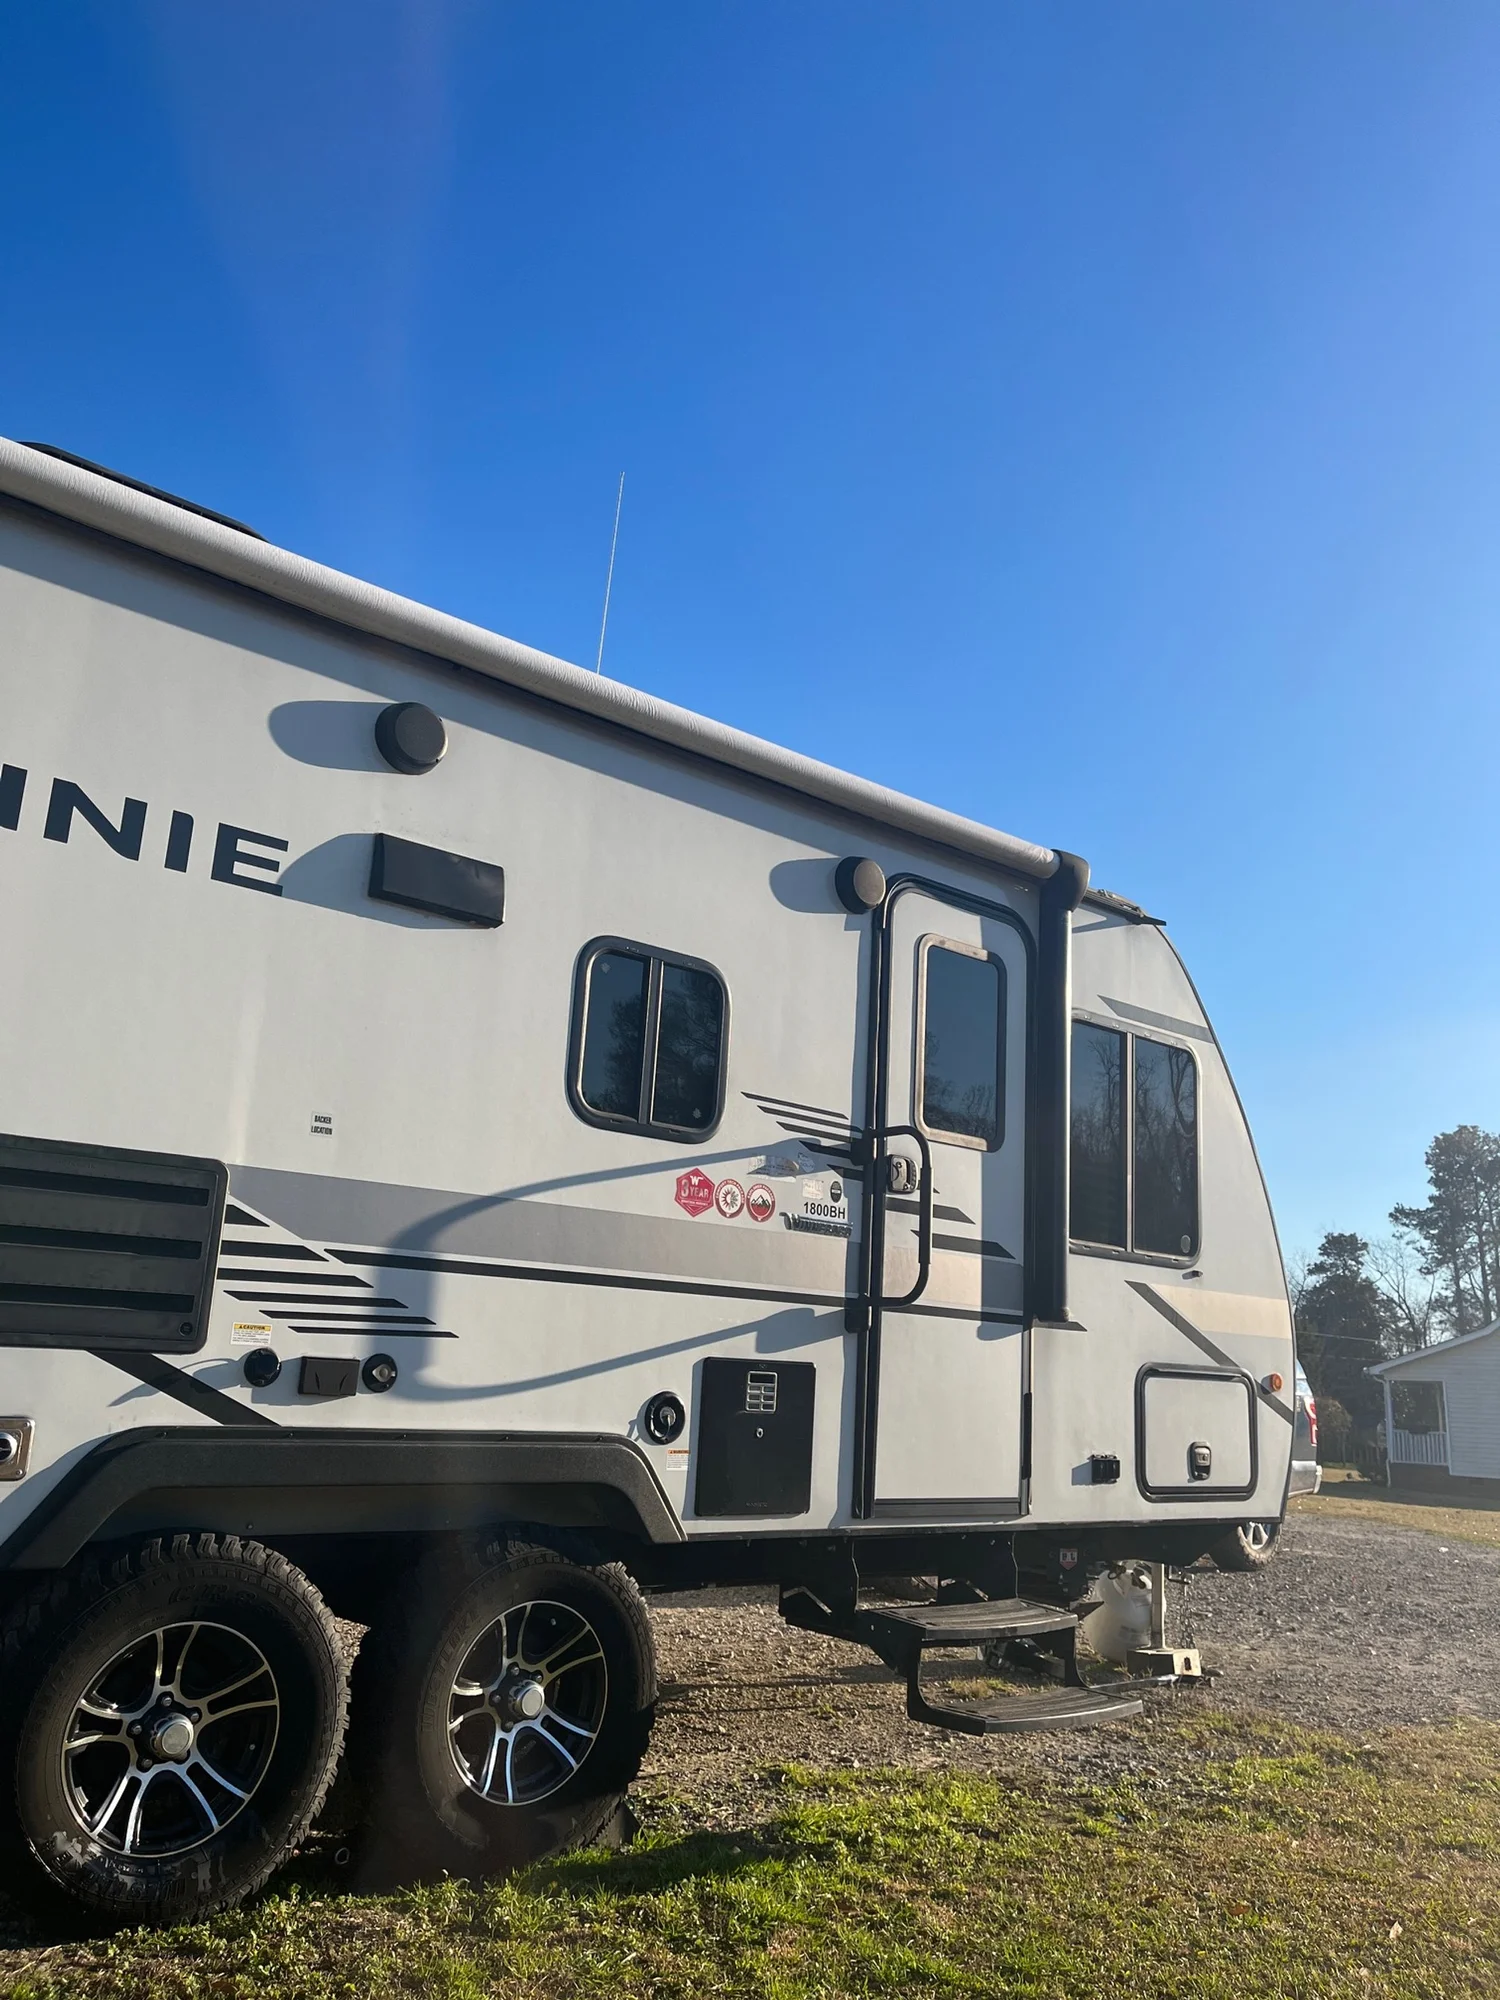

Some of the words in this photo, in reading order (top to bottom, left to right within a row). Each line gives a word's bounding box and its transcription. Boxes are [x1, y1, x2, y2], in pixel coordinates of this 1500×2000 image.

[0, 763, 289, 897] NIE
[314, 1115, 332, 1124] BACKER
[311, 1125, 332, 1135] LOCATION
[681, 1179, 690, 1198] 3
[690, 1186, 709, 1199] YEAR
[803, 1201, 846, 1220] 1800BH
